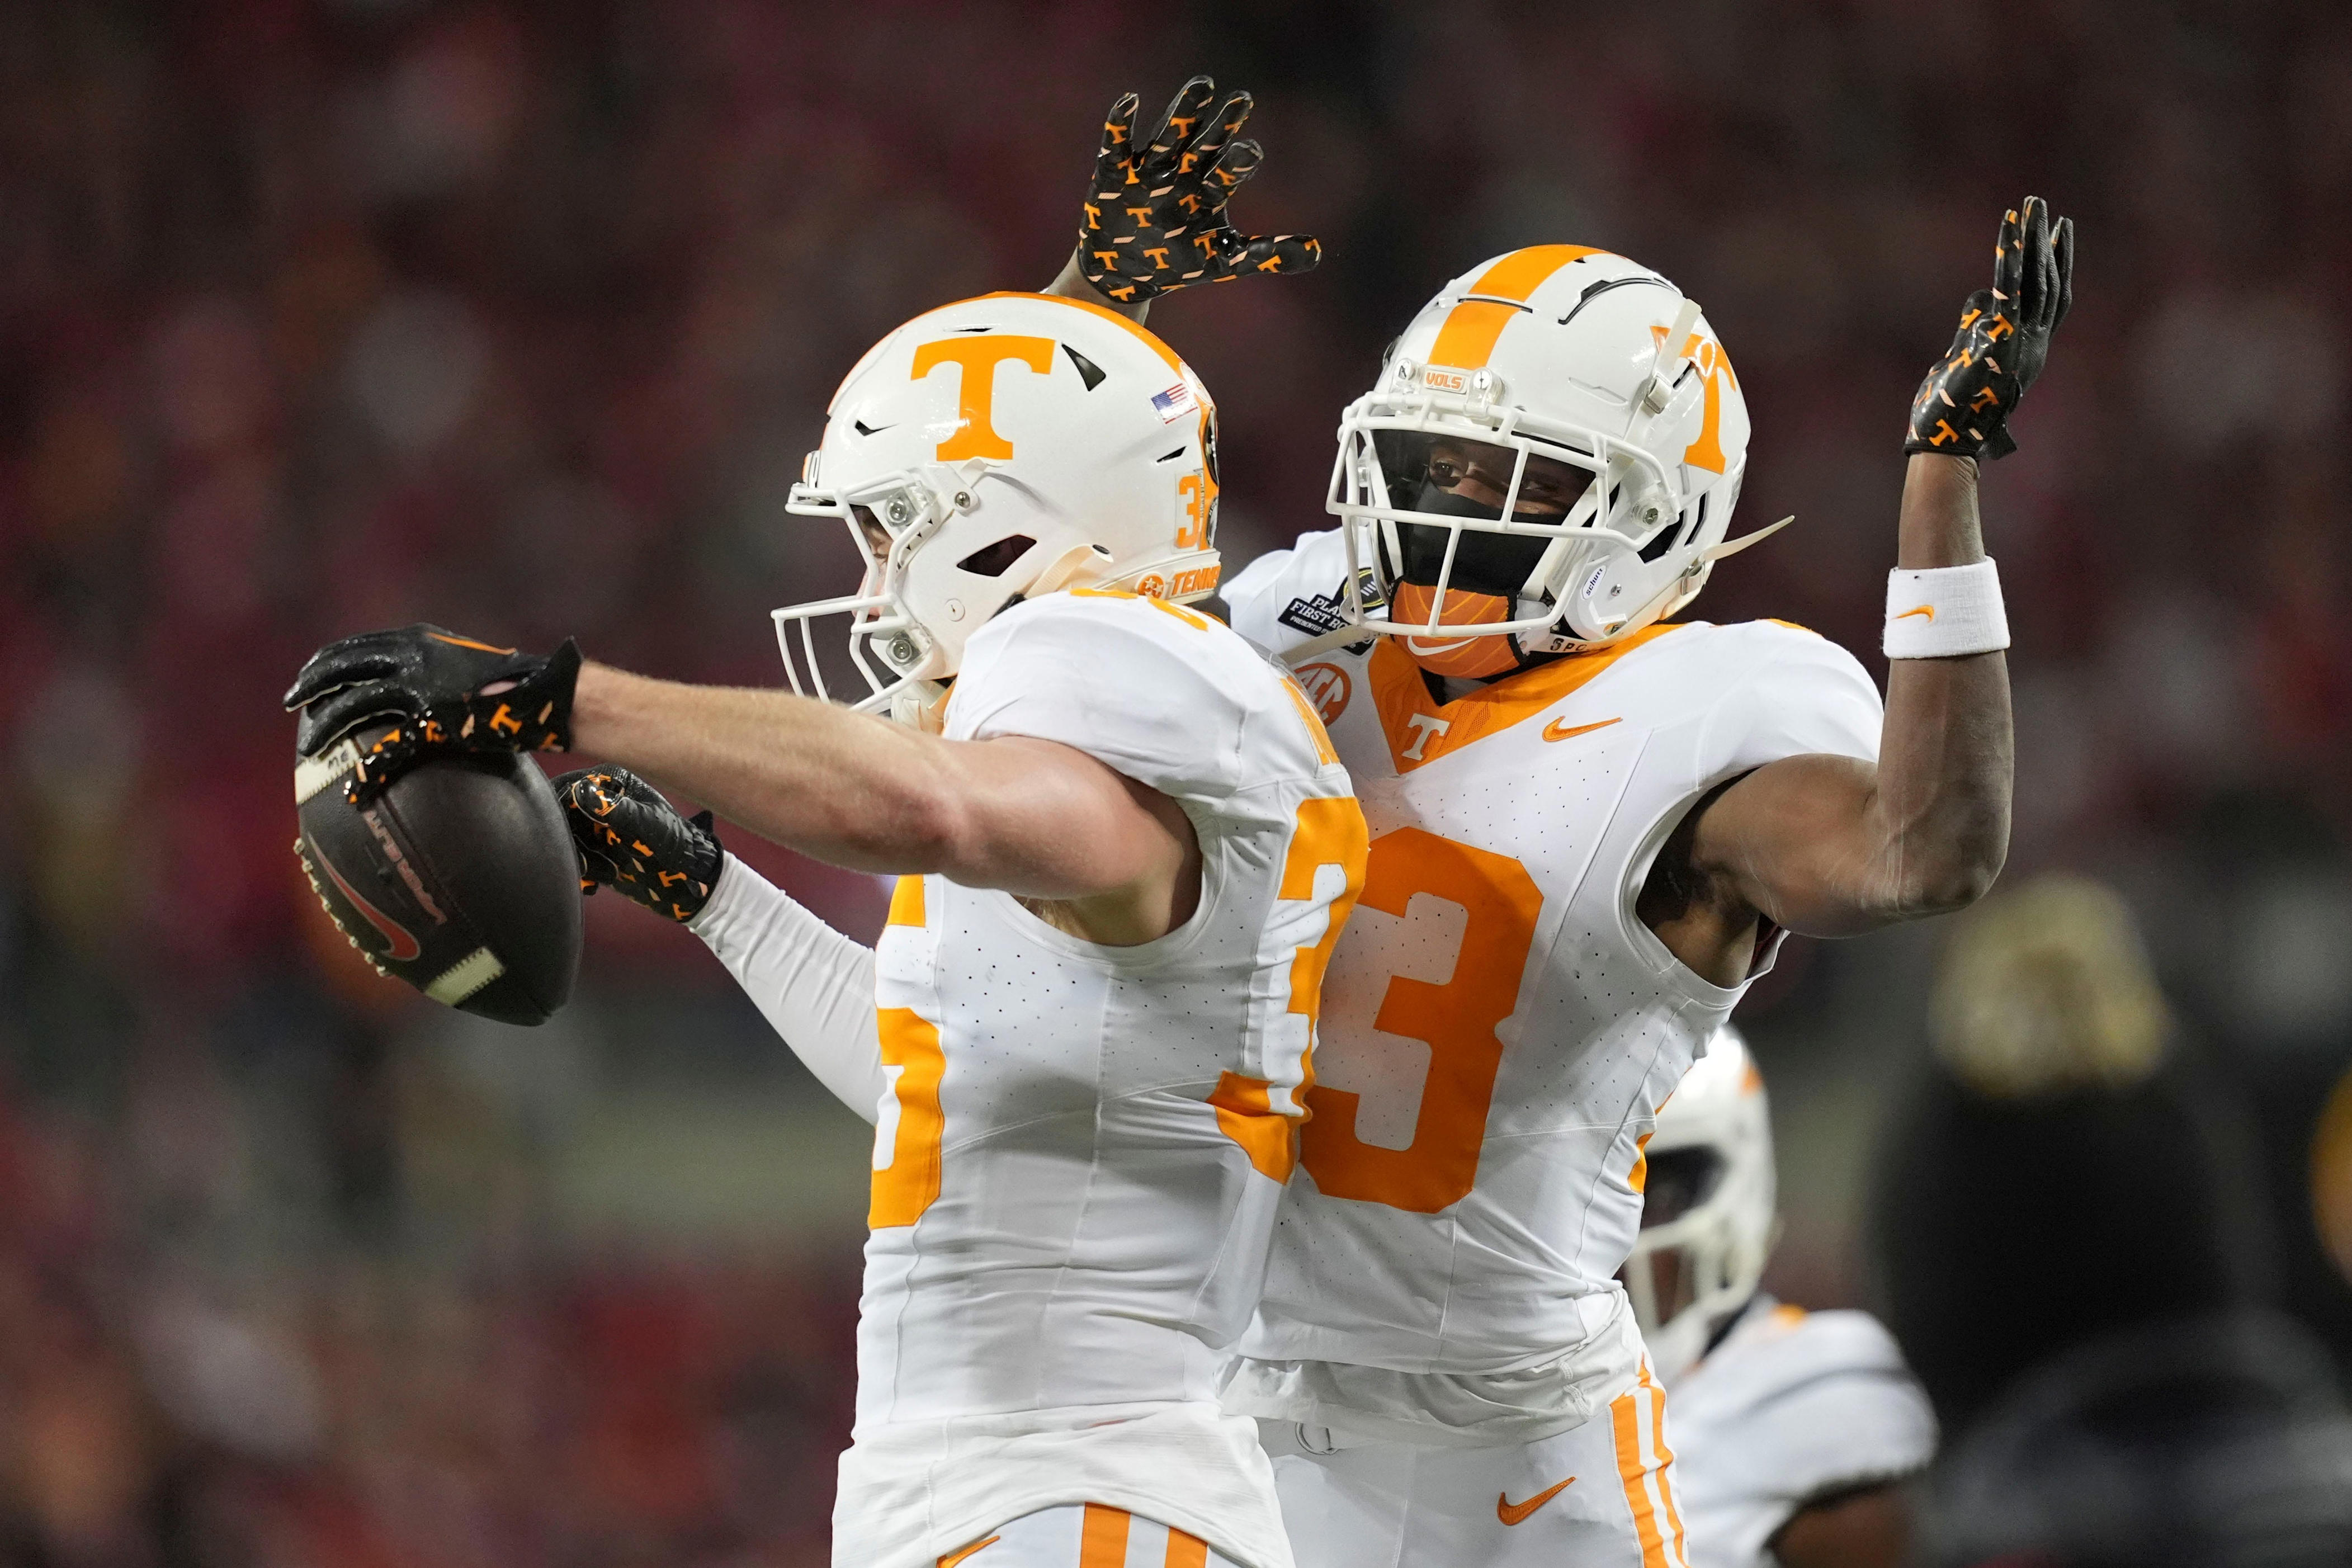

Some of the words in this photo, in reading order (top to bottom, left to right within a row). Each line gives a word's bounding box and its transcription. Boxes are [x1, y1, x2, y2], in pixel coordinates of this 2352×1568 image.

[1126, 207, 1153, 228] T
[1093, 251, 1119, 271] T
[1144, 247, 1170, 270] T
[1427, 372, 1462, 389] VOLS
[911, 336, 1055, 462] T
[1650, 325, 1736, 475] T
[1290, 601, 1331, 623] FIRST
[1290, 616, 1322, 632] PRESENTED
[489, 703, 522, 734] T
[1401, 713, 1450, 761] T
[1298, 826, 1544, 1213] 3
